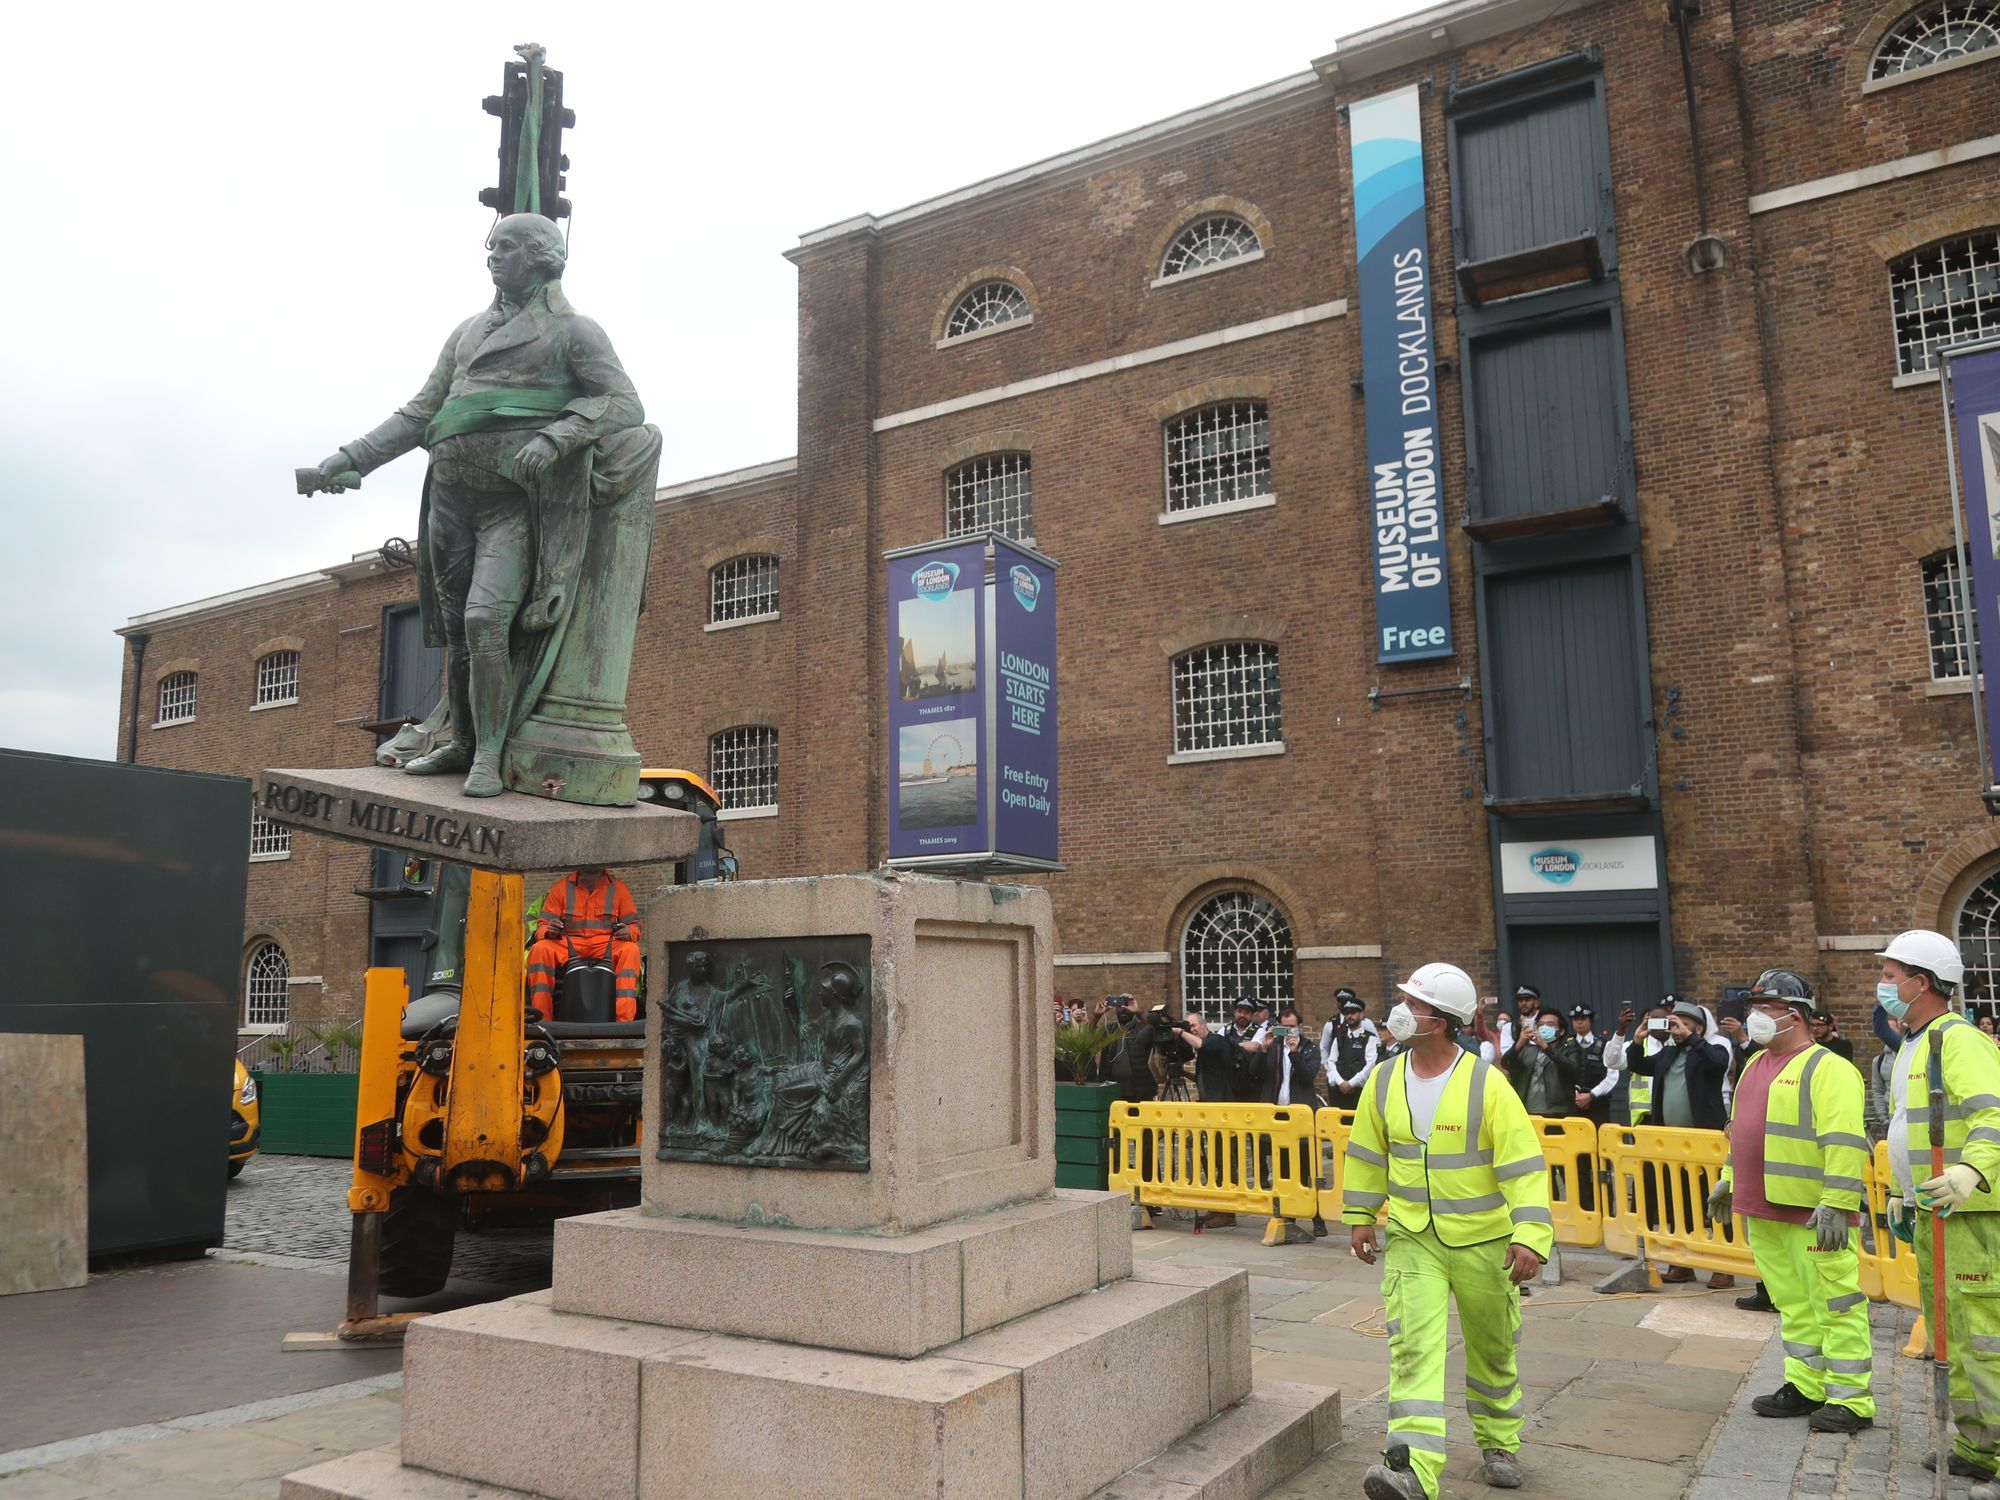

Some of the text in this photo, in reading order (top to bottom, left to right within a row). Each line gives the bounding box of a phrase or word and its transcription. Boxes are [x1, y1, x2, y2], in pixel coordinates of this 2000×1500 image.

[1393, 248, 1441, 588] OF LONDON DOCKLANDS
[1374, 461, 1410, 593] MUSEUM
[917, 568, 944, 579] MUSEUM
[917, 574, 950, 587] OF LONDON
[918, 583, 950, 593] DOCKLANDS
[1383, 626, 1446, 651] Free
[1001, 651, 1049, 682] LONDON
[1006, 679, 1045, 705] STARTS
[920, 706, 943, 715] THAMES
[1012, 704, 1040, 728] HERE
[1004, 765, 1049, 793] Free Entry
[1002, 788, 1051, 816] Open Daily
[264, 781, 506, 858] ROBT MILLIGAN
[1534, 856, 1568, 865] MUSEUM
[1534, 861, 1624, 872] OF LONDON DOCKLANDS
[1955, 1272, 1988, 1281] RINEY
